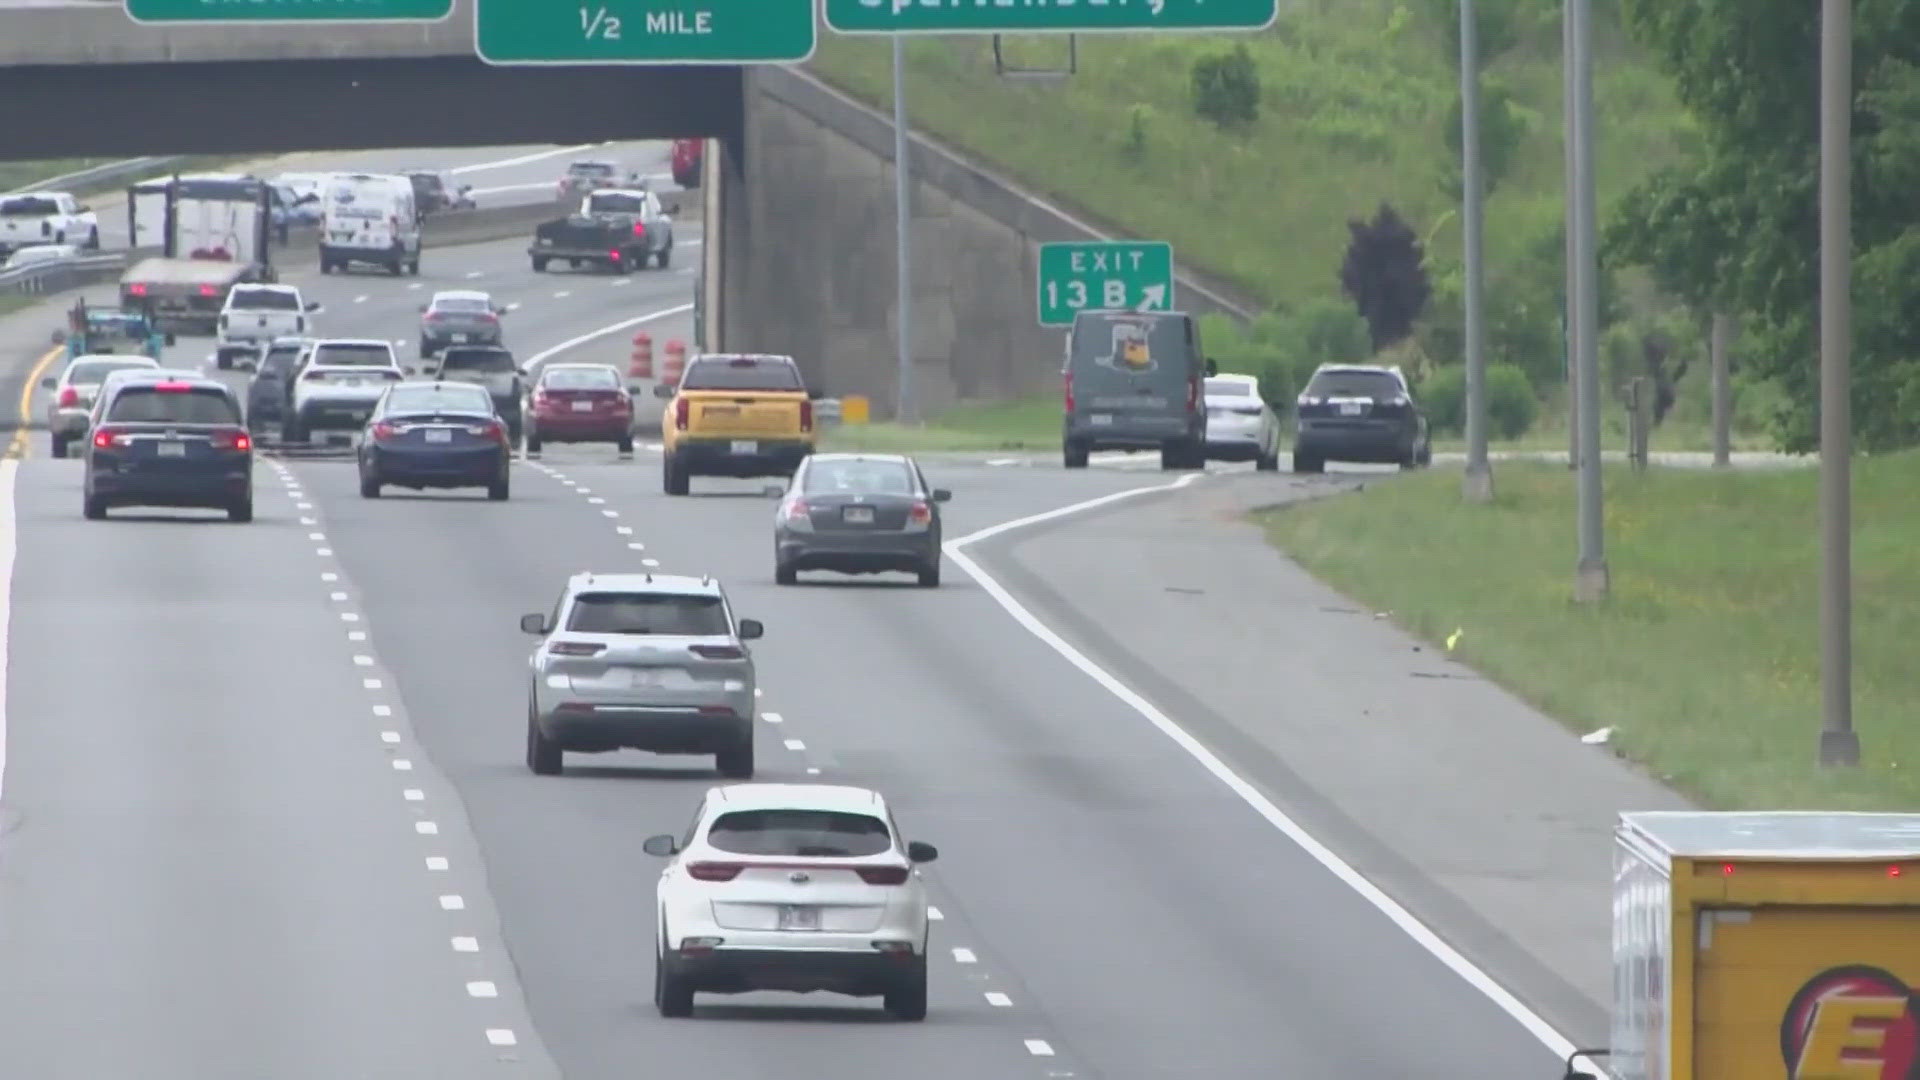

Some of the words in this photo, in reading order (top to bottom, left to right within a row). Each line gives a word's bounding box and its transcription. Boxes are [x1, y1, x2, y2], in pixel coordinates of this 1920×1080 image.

[646, 11, 712, 34] MILE
[1070, 251, 1144, 273] EXIT
[1047, 280, 1088, 309] 13
[1103, 280, 1127, 308] B
